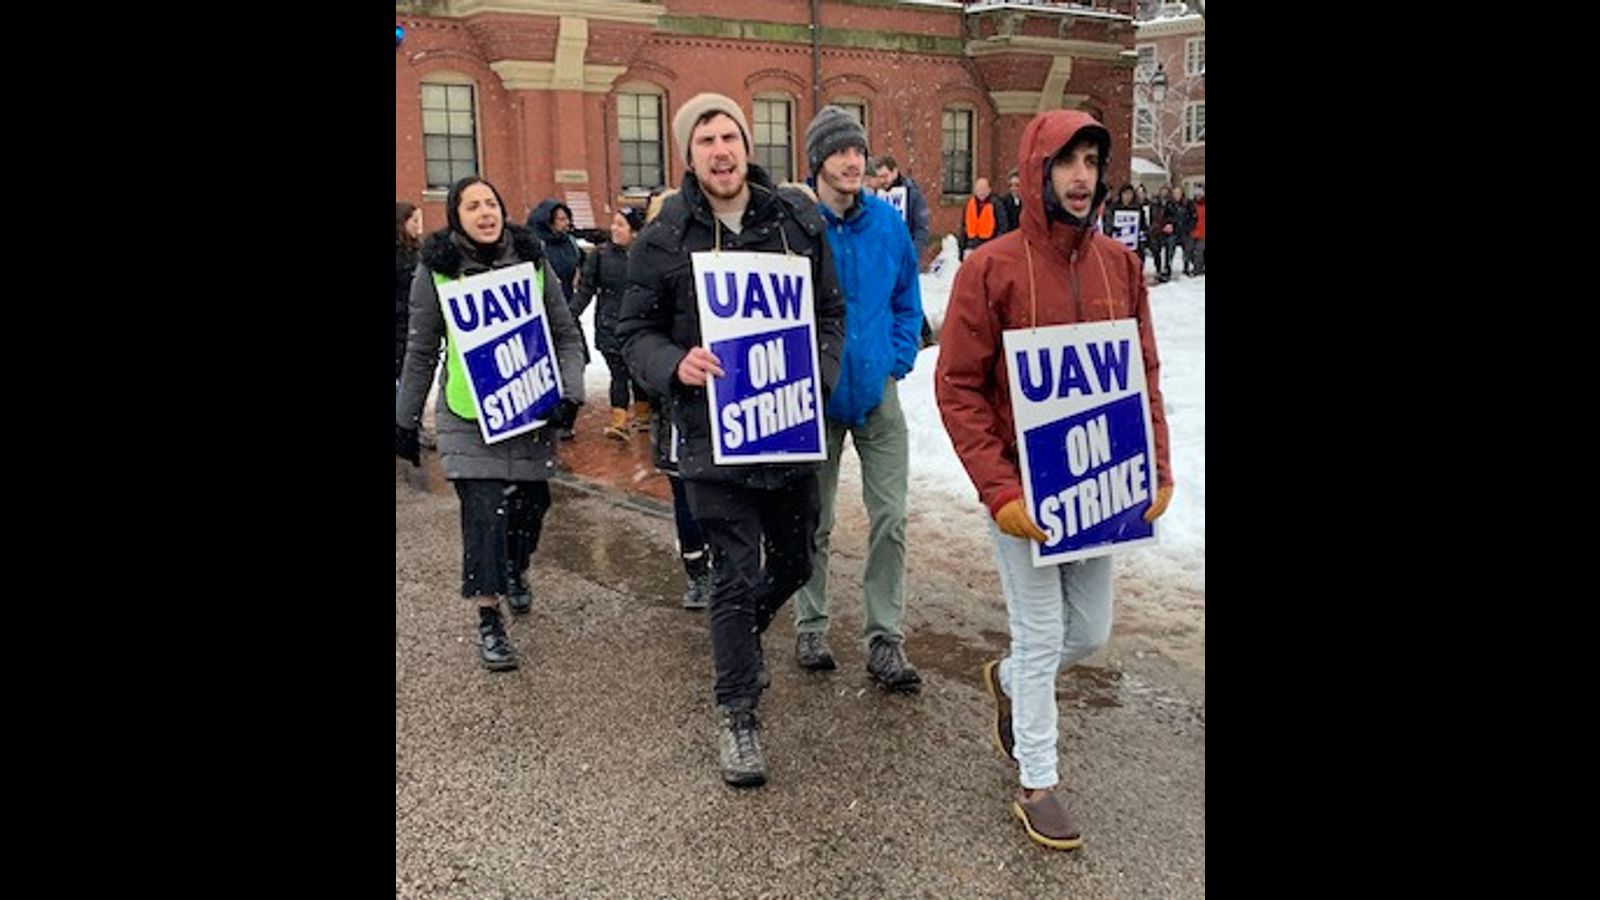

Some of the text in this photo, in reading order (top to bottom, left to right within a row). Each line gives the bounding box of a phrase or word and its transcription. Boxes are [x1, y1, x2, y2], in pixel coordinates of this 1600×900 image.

[448, 278, 532, 332] UAW
[704, 271, 804, 320] UAW
[494, 332, 529, 379] ON
[748, 337, 786, 390] ON
[1016, 340, 1129, 402] UAW
[483, 355, 556, 430] STRIKE
[722, 377, 815, 450] STRIKE
[1066, 413, 1111, 477] ON
[1039, 453, 1149, 547] STRIKE
